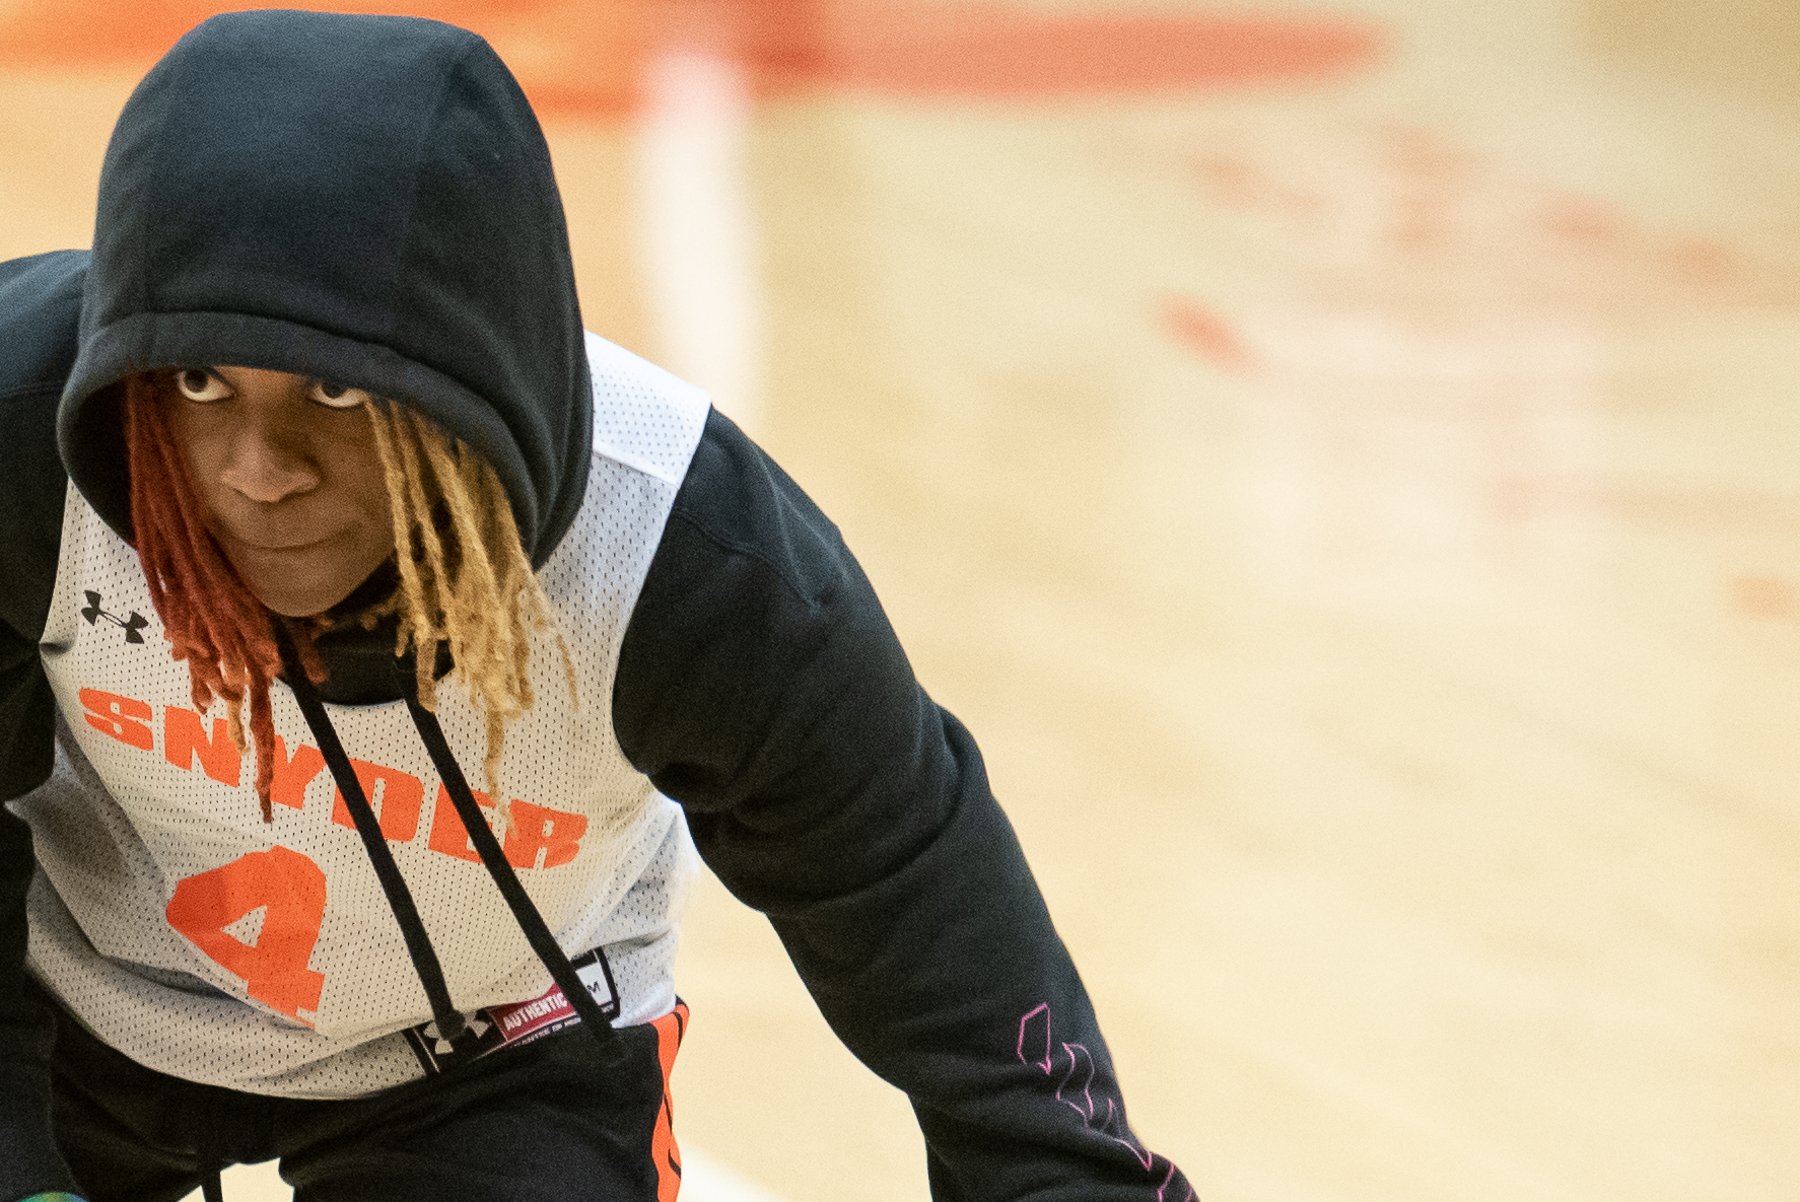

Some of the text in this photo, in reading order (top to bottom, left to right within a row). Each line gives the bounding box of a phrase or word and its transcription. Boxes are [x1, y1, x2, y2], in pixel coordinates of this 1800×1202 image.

[79, 687, 588, 869] SNYDER
[166, 845, 327, 1029] 4
[503, 992, 568, 1031] AUTHENTIC
